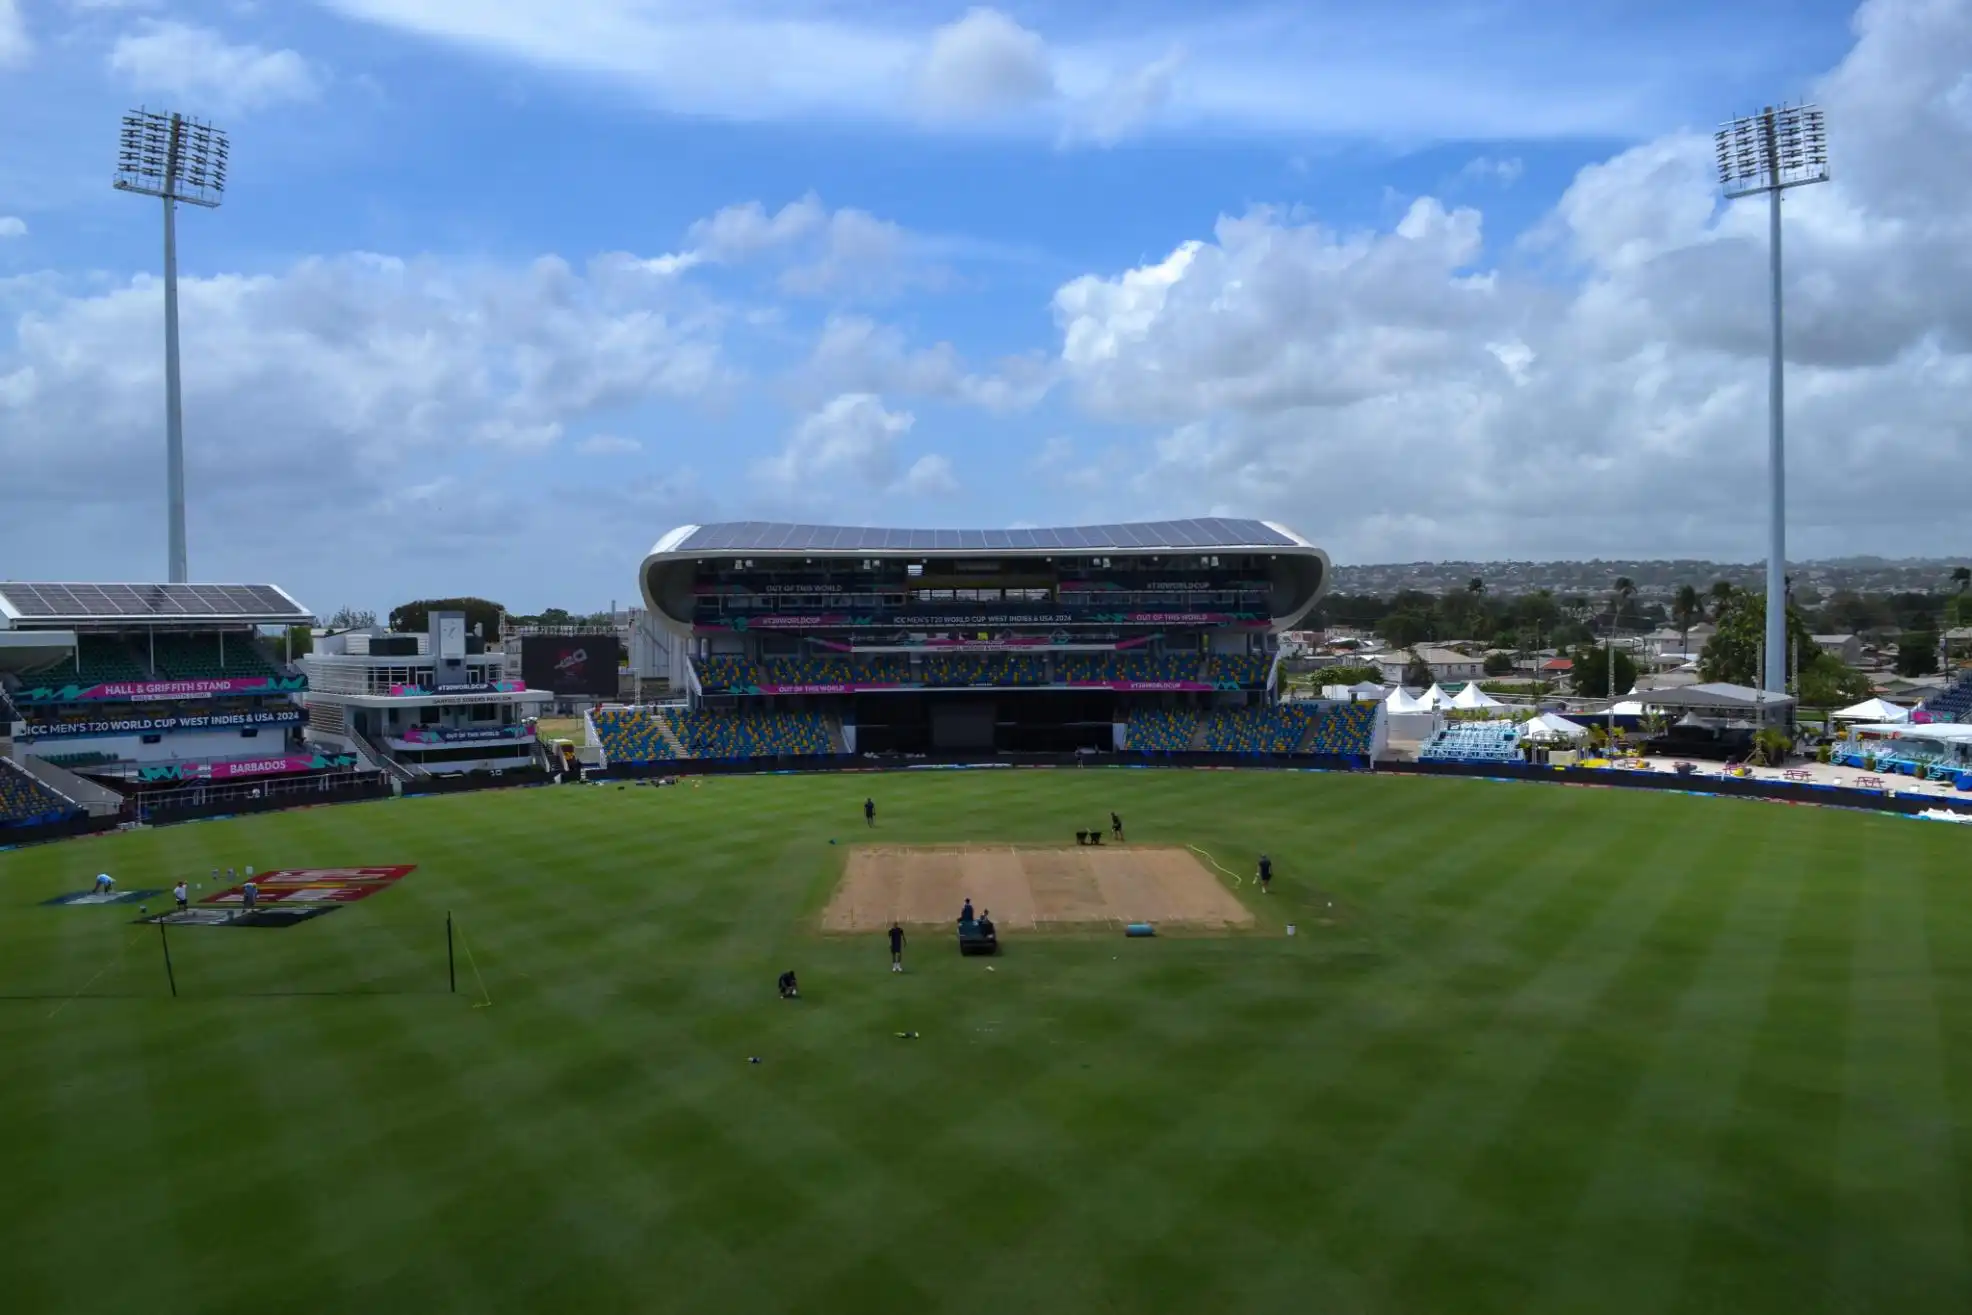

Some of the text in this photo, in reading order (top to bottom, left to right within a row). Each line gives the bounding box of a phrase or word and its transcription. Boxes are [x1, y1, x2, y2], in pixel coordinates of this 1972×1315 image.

[105, 686, 134, 695] HALL
[146, 682, 194, 693] GRIFFITH
[196, 681, 231, 691] STAND
[27, 725, 48, 734] ICC
[50, 723, 86, 733] MEN'S
[87, 722, 108, 731] T20
[110, 720, 152, 730] WORLD
[154, 718, 176, 728] CUP
[180, 716, 209, 726] WEST
[211, 715, 244, 725] INDIES
[254, 713, 274, 722] USA
[277, 712, 299, 720] 2024
[230, 760, 286, 773] BARBADOS
